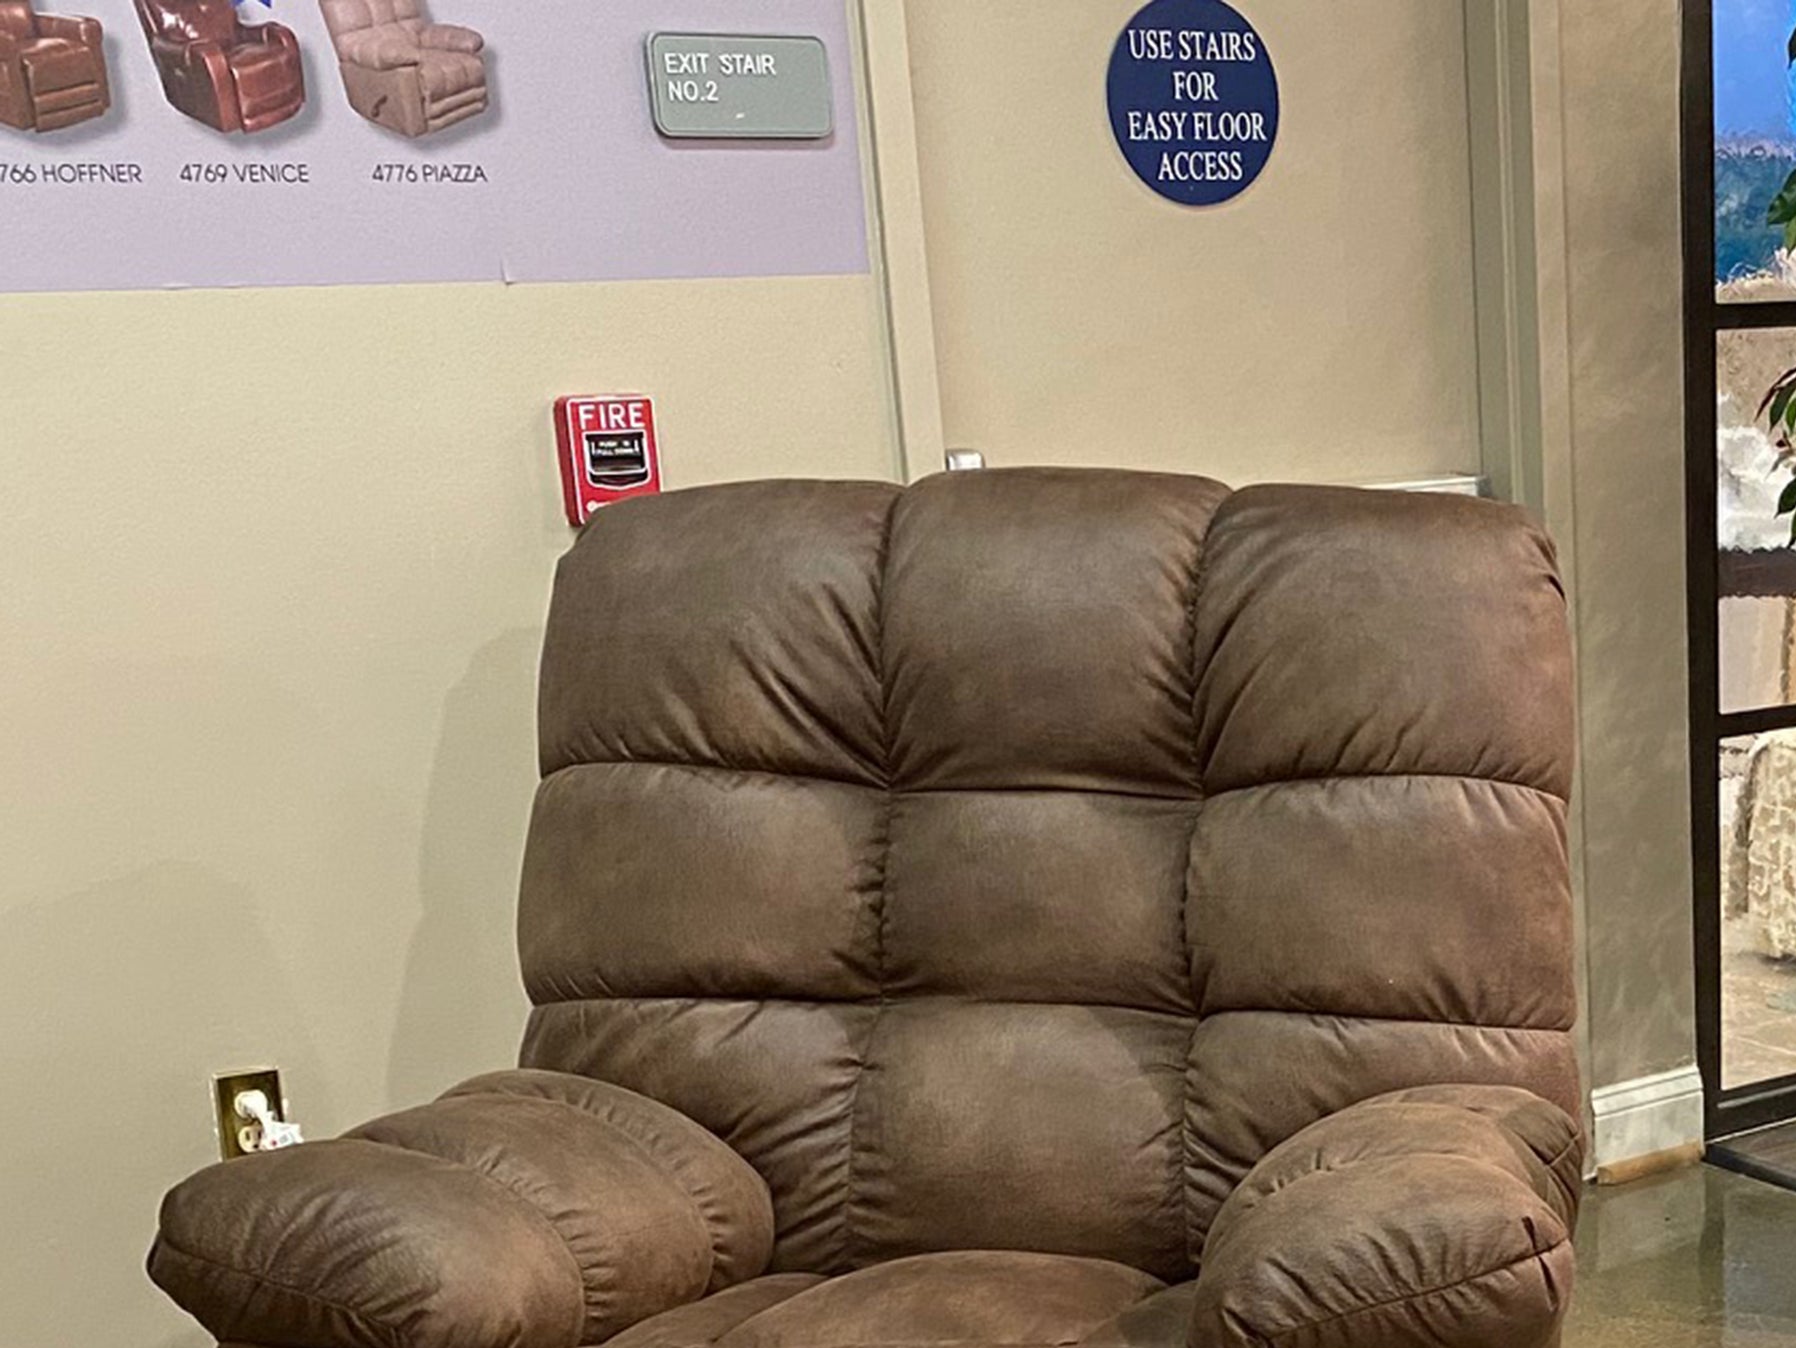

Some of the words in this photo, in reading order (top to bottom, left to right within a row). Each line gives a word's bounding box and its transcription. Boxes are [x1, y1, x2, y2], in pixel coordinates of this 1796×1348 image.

[1128, 29, 1174, 60] USE
[1178, 30, 1256, 61] STAIRS
[664, 53, 709, 74] EXIT
[719, 54, 776, 75] STAIR
[668, 80, 719, 102] NO.2
[1173, 71, 1219, 101] FOR
[1128, 111, 1187, 141] EASY
[1192, 112, 1267, 141] FLOOR
[41, 163, 143, 184] HOFFNER
[179, 164, 228, 183] 4769
[232, 164, 310, 183] VENICE
[371, 164, 418, 183] 4776
[422, 164, 488, 183] PIAZZA
[1158, 151, 1243, 181] ACCESS
[578, 402, 646, 430] FIRE
